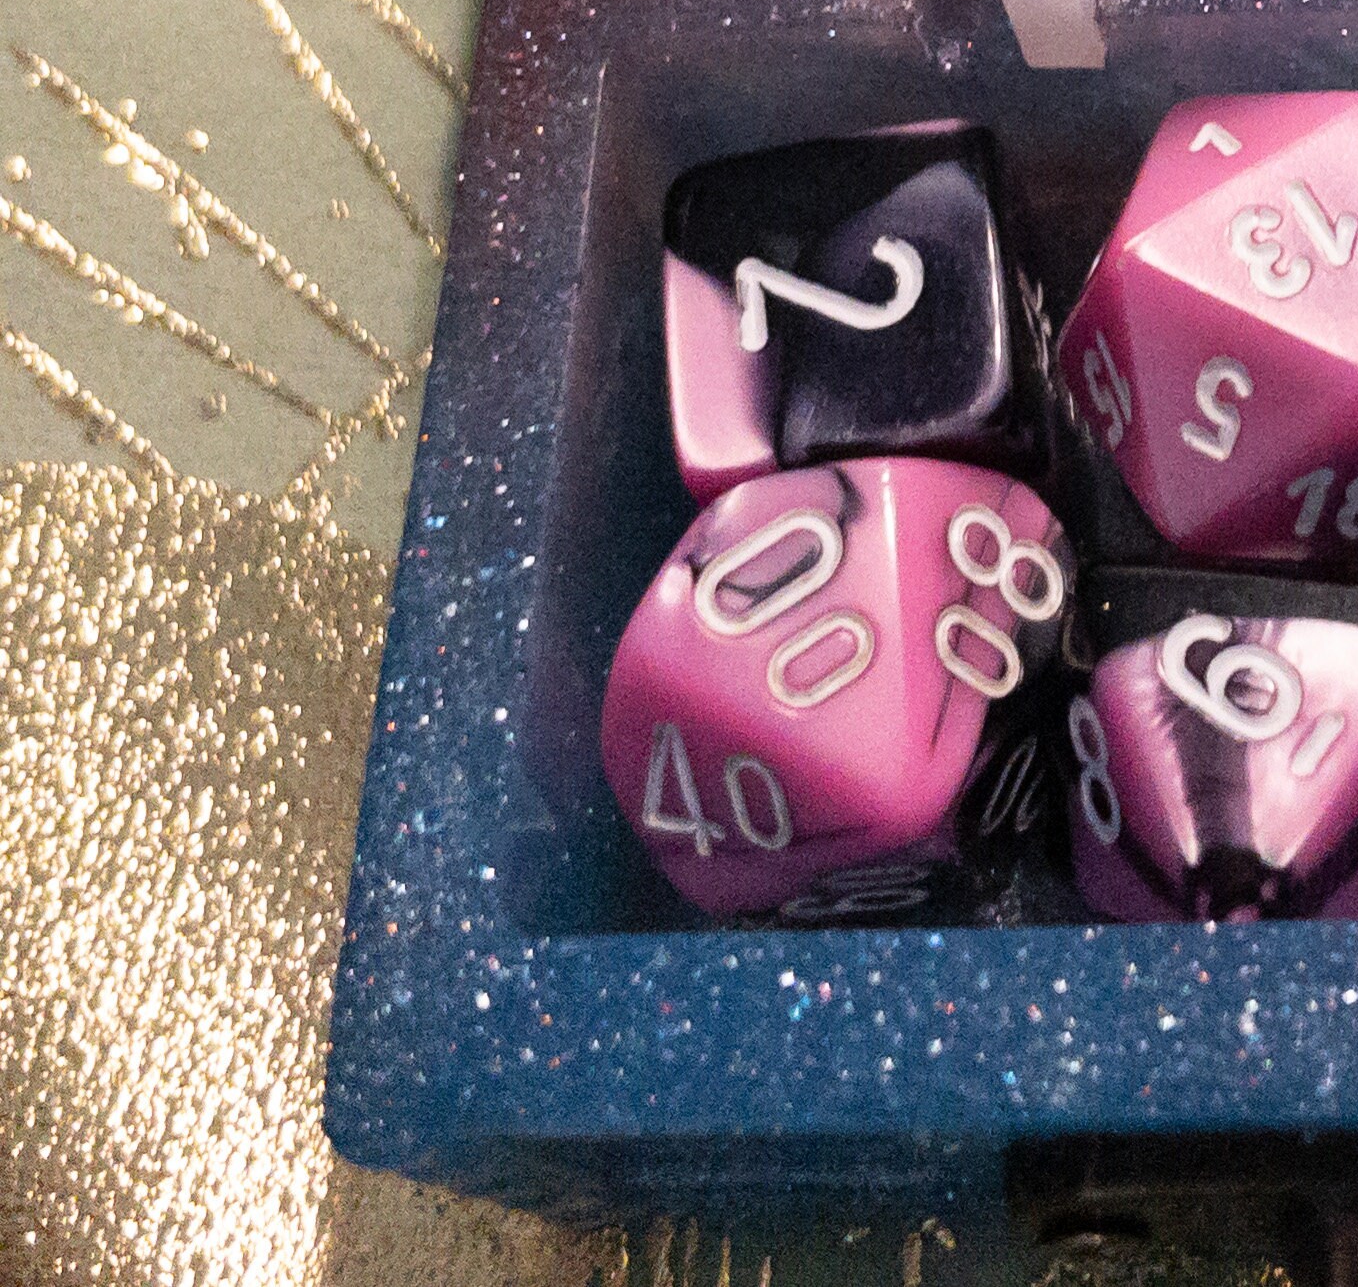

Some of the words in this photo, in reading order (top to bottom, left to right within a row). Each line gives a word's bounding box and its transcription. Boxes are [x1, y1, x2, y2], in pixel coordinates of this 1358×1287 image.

[735, 234, 925, 354] 2
[1180, 355, 1254, 463] 5
[694, 509, 876, 709] 00
[934, 502, 1065, 699] 80
[1160, 611, 1303, 742] 6
[642, 722, 793, 857] 40
[1067, 695, 1122, 846] 8
